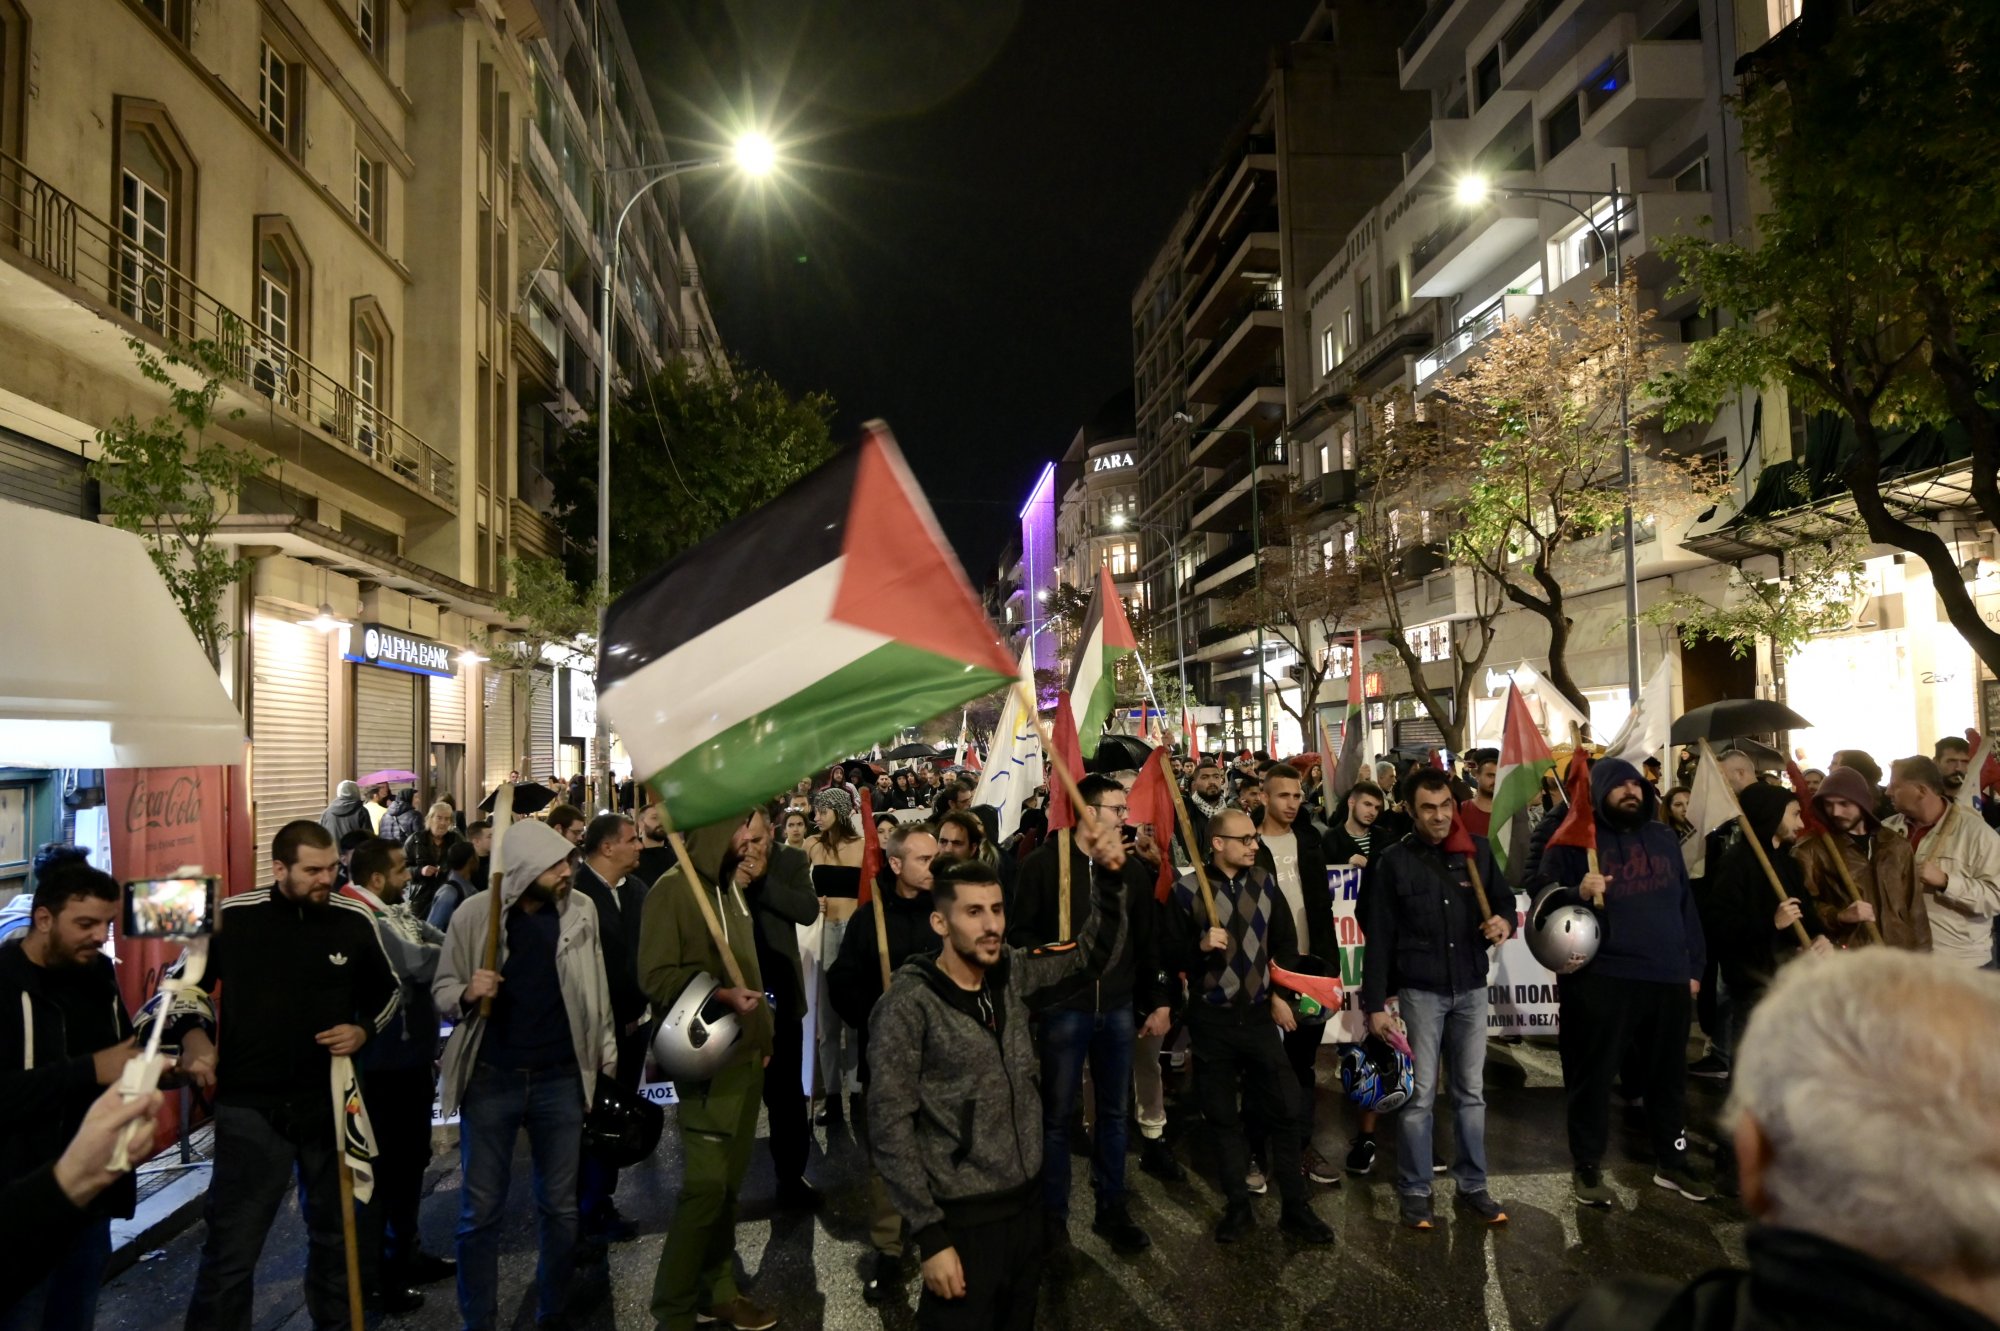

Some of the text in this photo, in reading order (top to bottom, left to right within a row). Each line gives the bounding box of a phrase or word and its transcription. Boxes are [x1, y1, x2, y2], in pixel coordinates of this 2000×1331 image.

[1094, 453, 1134, 471] ZARA
[379, 633, 449, 670] ALPHA BANK
